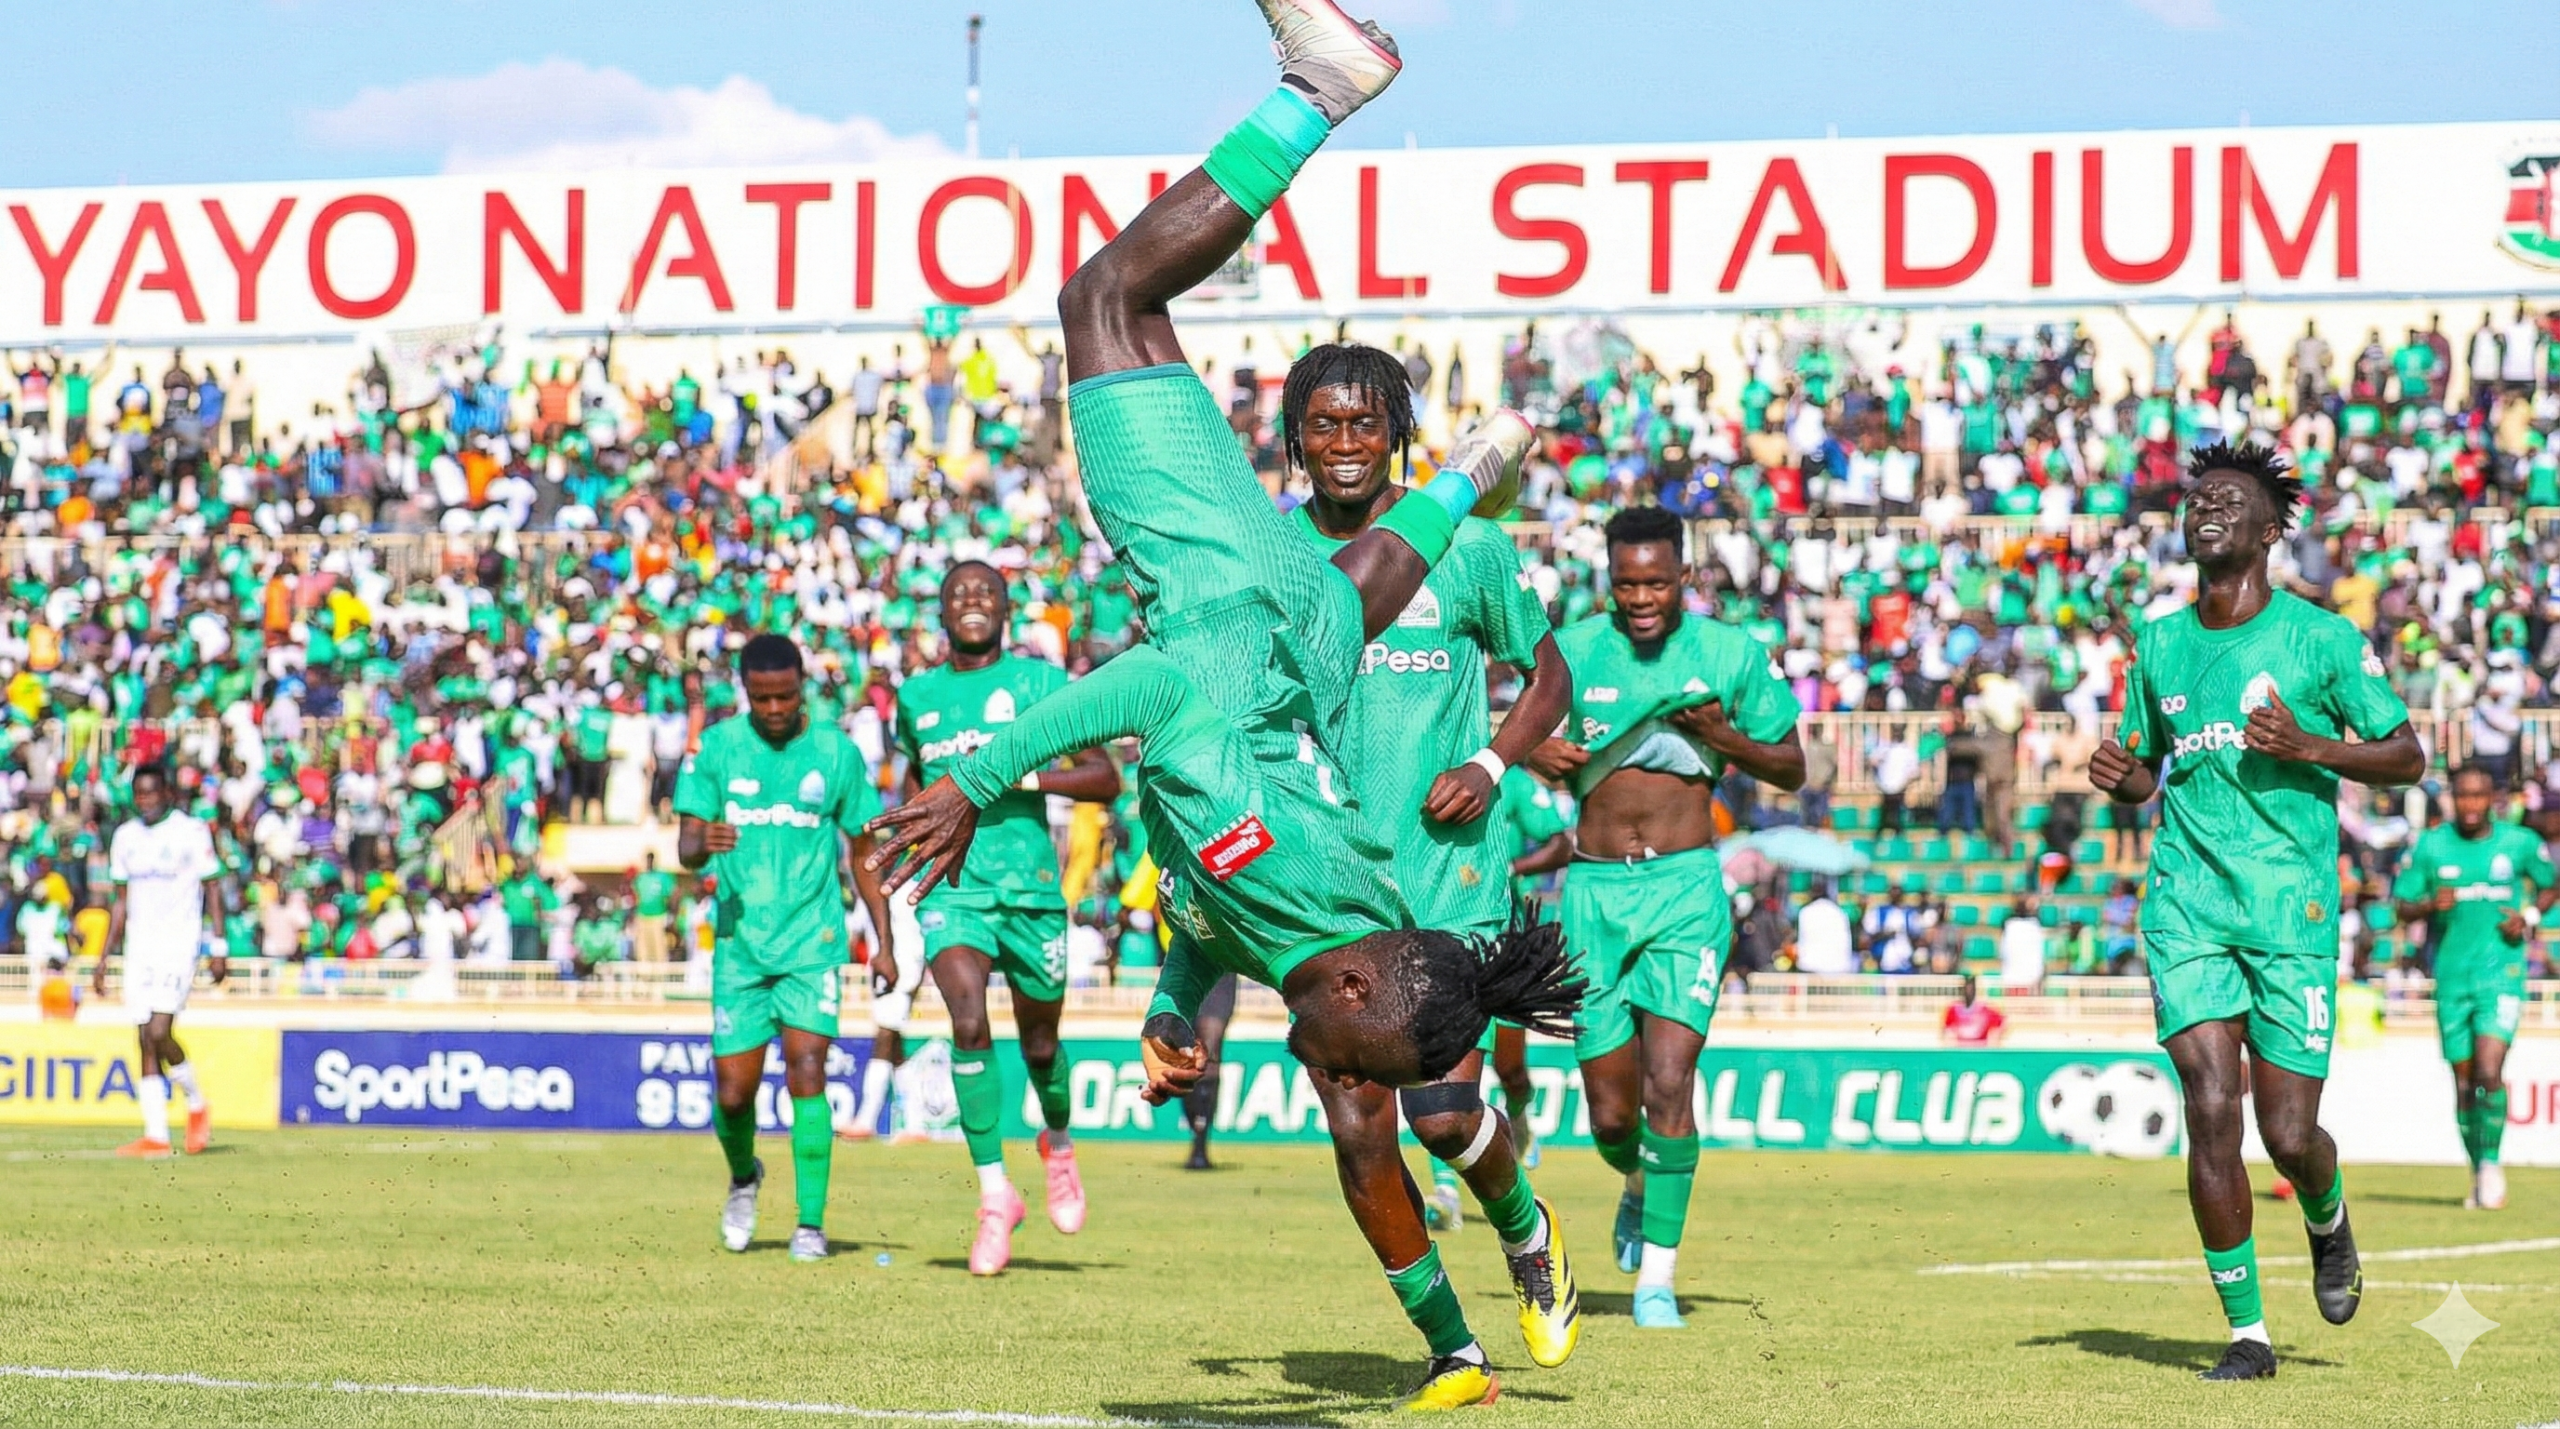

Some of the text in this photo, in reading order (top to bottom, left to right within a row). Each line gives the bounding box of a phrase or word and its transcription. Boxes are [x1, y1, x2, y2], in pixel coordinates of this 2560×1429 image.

[9, 194, 417, 326] YAYO
[1491, 143, 2359, 298] STADIUM
[1357, 641, 1451, 676] Pesa
[2302, 985, 2330, 1031] 16
[314, 1048, 575, 1124] SportPesa
[1830, 1069, 2024, 1146] CLUB
